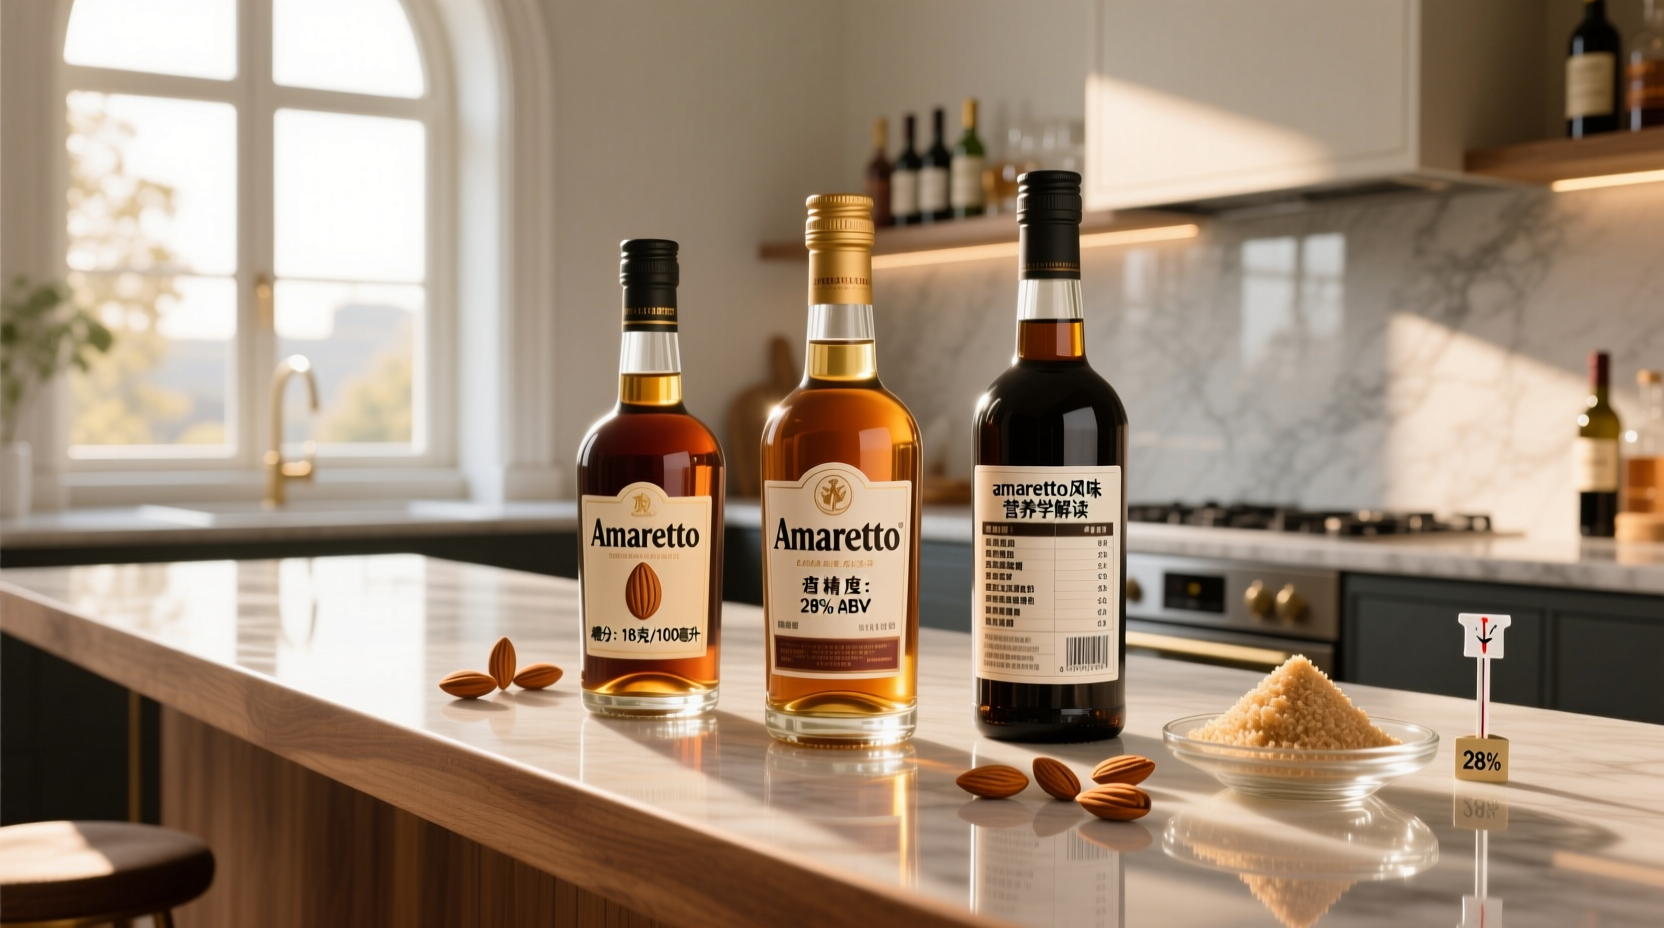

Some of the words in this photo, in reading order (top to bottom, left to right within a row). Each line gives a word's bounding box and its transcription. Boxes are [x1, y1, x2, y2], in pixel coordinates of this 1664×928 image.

[992, 478, 1102, 499] amaretto风味
[1003, 498, 1089, 519] 营养学解读
[591, 517, 700, 548] Amaretto
[774, 517, 900, 551] Amaretto
[838, 598, 872, 614] ABV
[1463, 749, 1501, 771] 28%
